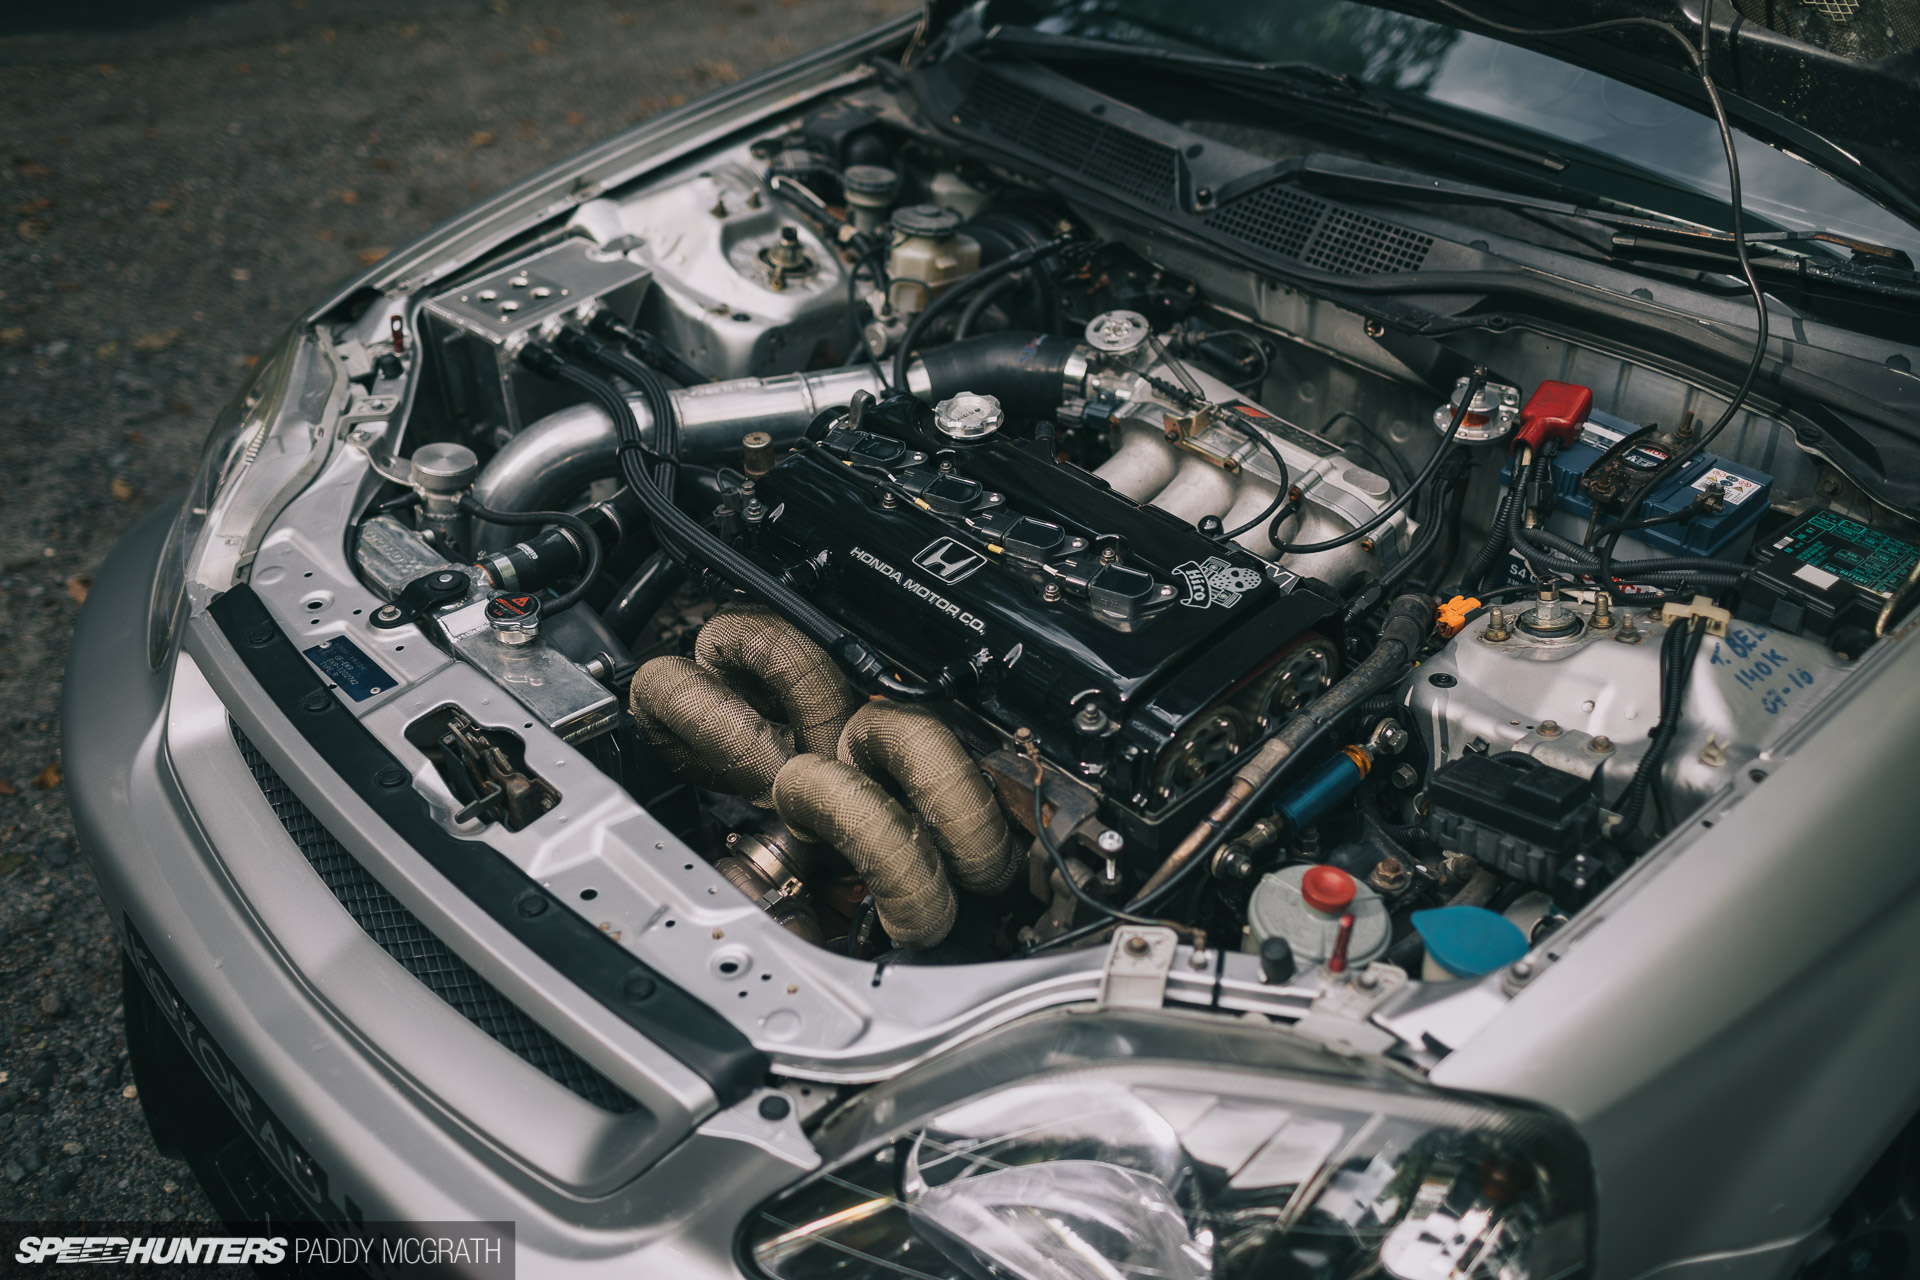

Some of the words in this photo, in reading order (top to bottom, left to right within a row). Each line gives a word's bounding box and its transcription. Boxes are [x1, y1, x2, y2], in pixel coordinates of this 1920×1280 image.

[850, 547, 903, 585] HONDA
[903, 579, 961, 619] MOTOR
[1186, 569, 1206, 601] Hiro
[1510, 564, 1527, 579] S4
[1840, 570, 1868, 584] BATTERY
[1734, 648, 1789, 691] 140K
